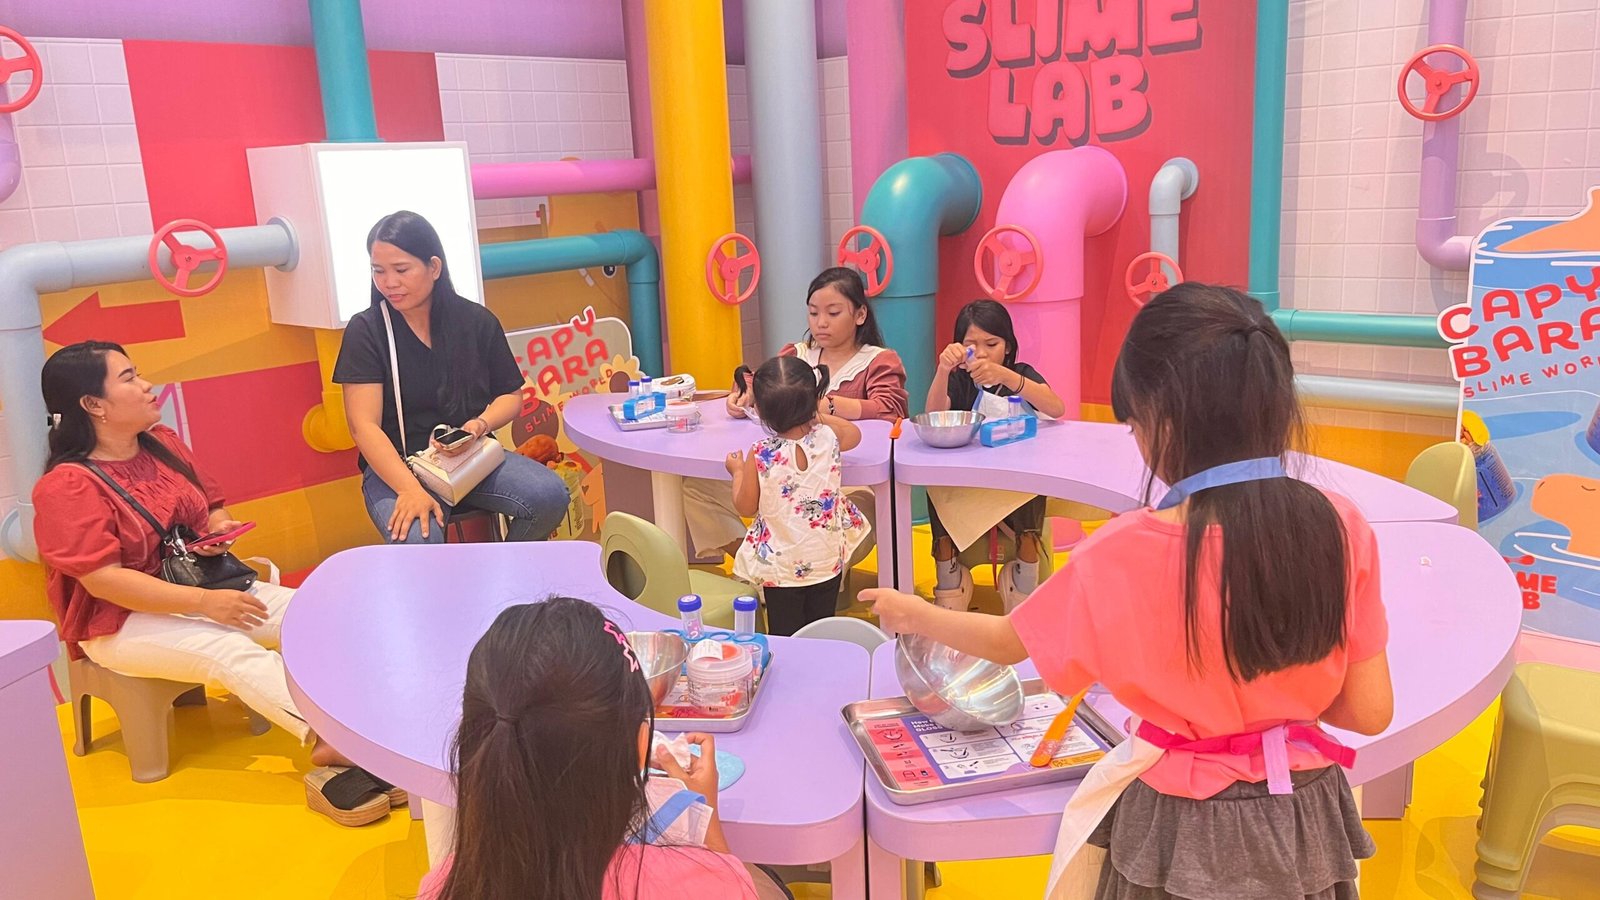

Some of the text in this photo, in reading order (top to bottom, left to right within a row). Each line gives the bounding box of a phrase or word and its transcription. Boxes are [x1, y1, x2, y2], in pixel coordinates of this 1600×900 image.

[942, 0, 1203, 78] SLIME
[987, 55, 1152, 146] LAB
[1440, 266, 1600, 340] CAPY
[517, 309, 594, 378] APY
[520, 338, 609, 418] BARA
[1463, 355, 1600, 398] SLIME WOR
[525, 400, 564, 433] SLIME
